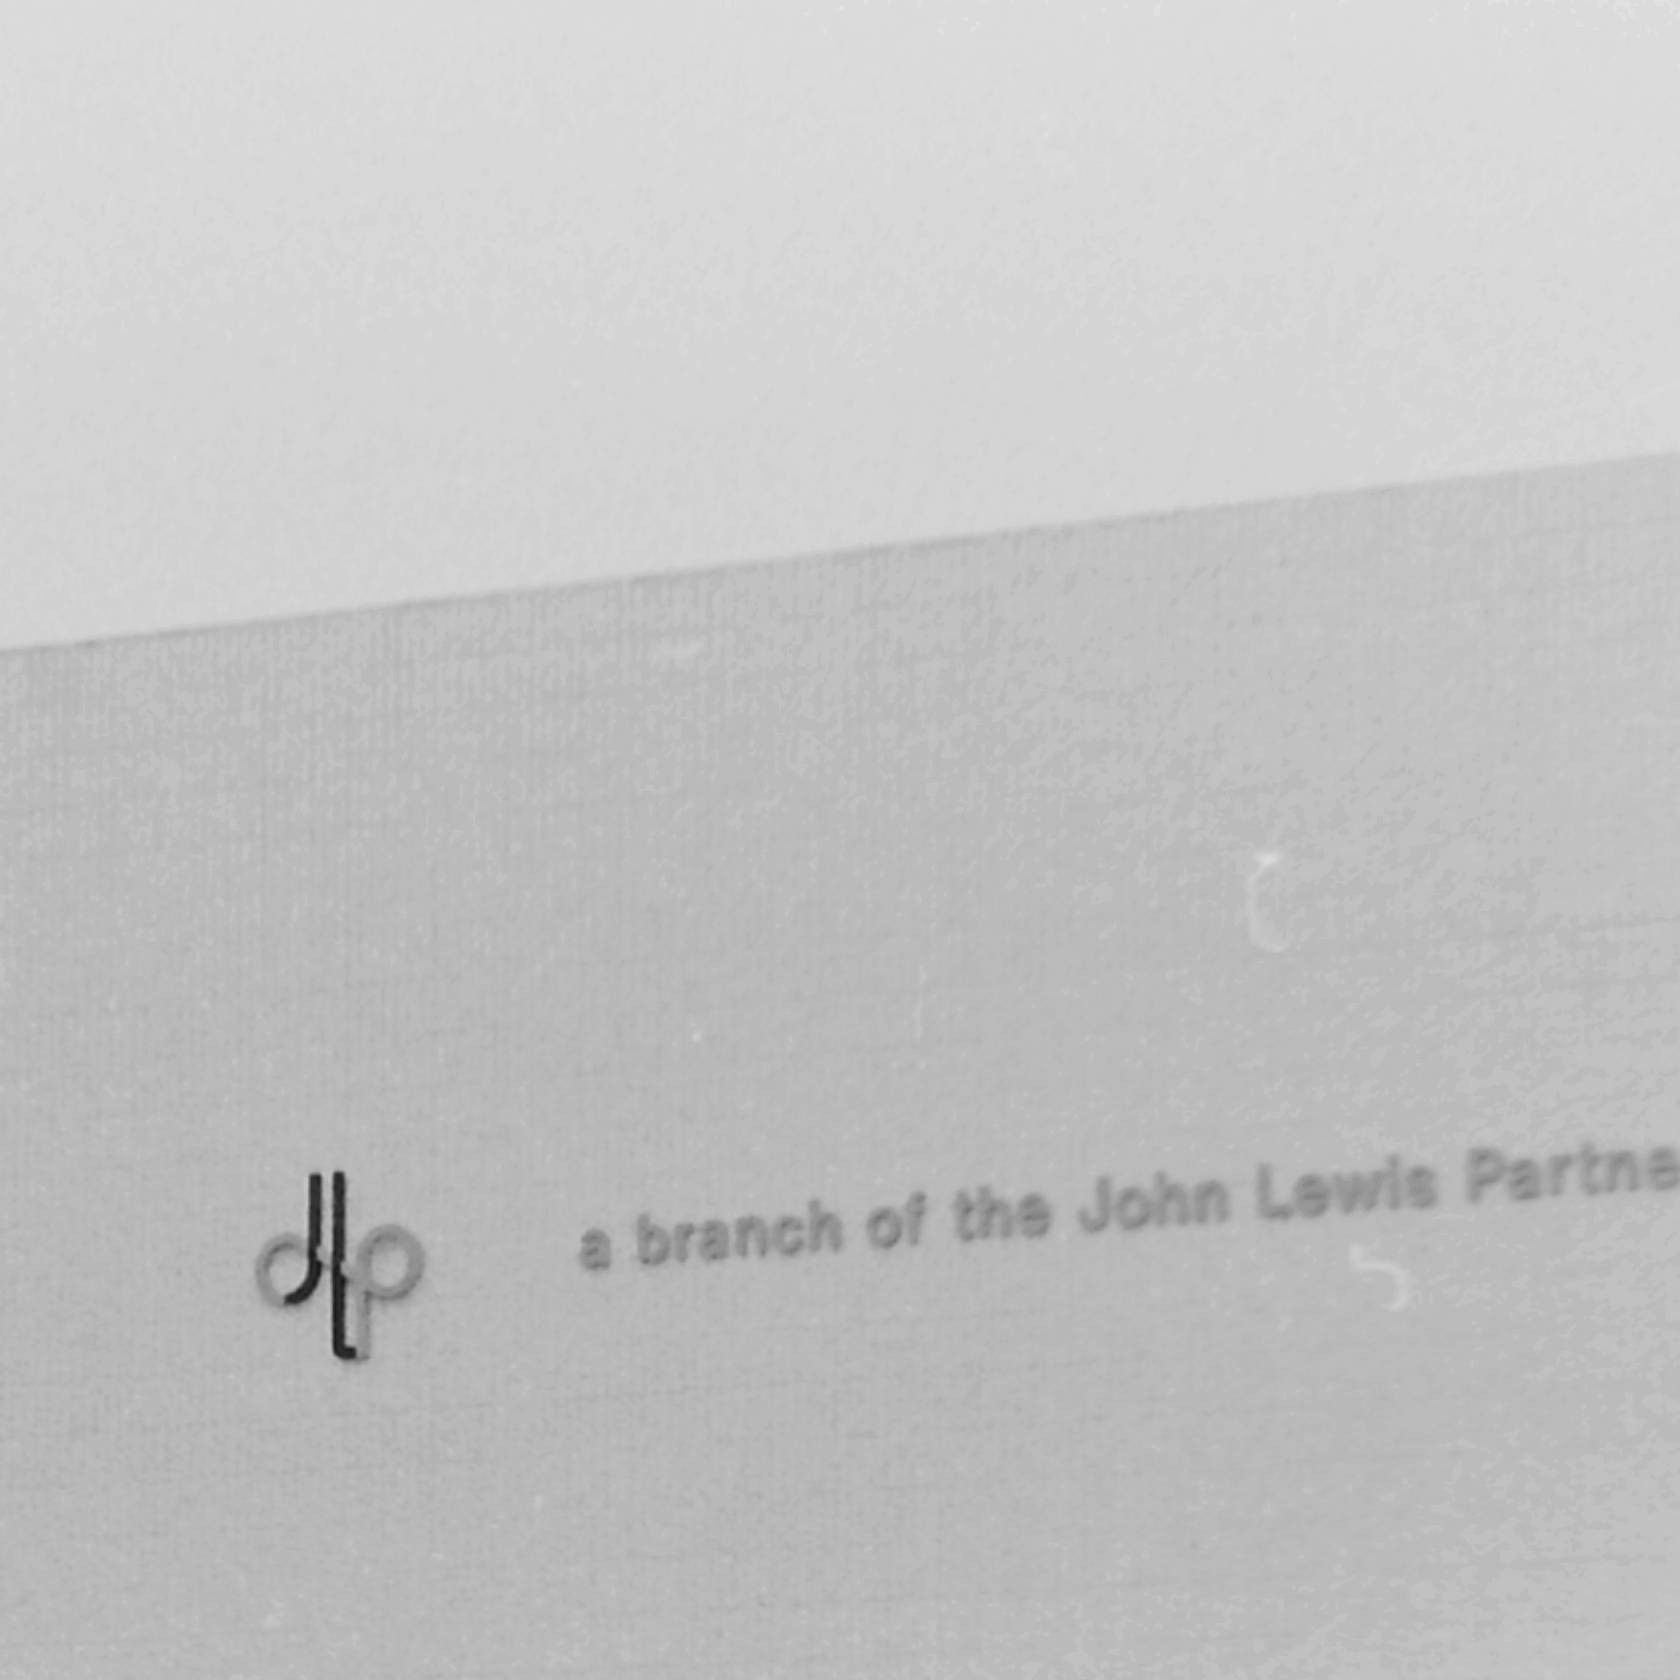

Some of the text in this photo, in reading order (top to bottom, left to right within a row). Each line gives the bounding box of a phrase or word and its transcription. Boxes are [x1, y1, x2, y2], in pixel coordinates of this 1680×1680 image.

[580, 1227, 613, 1272] a
[636, 1200, 844, 1267] branch
[866, 1190, 928, 1250] of
[954, 1186, 1053, 1243] the
[1077, 1170, 1231, 1234] John
[1255, 1154, 1439, 1221] Lewis
